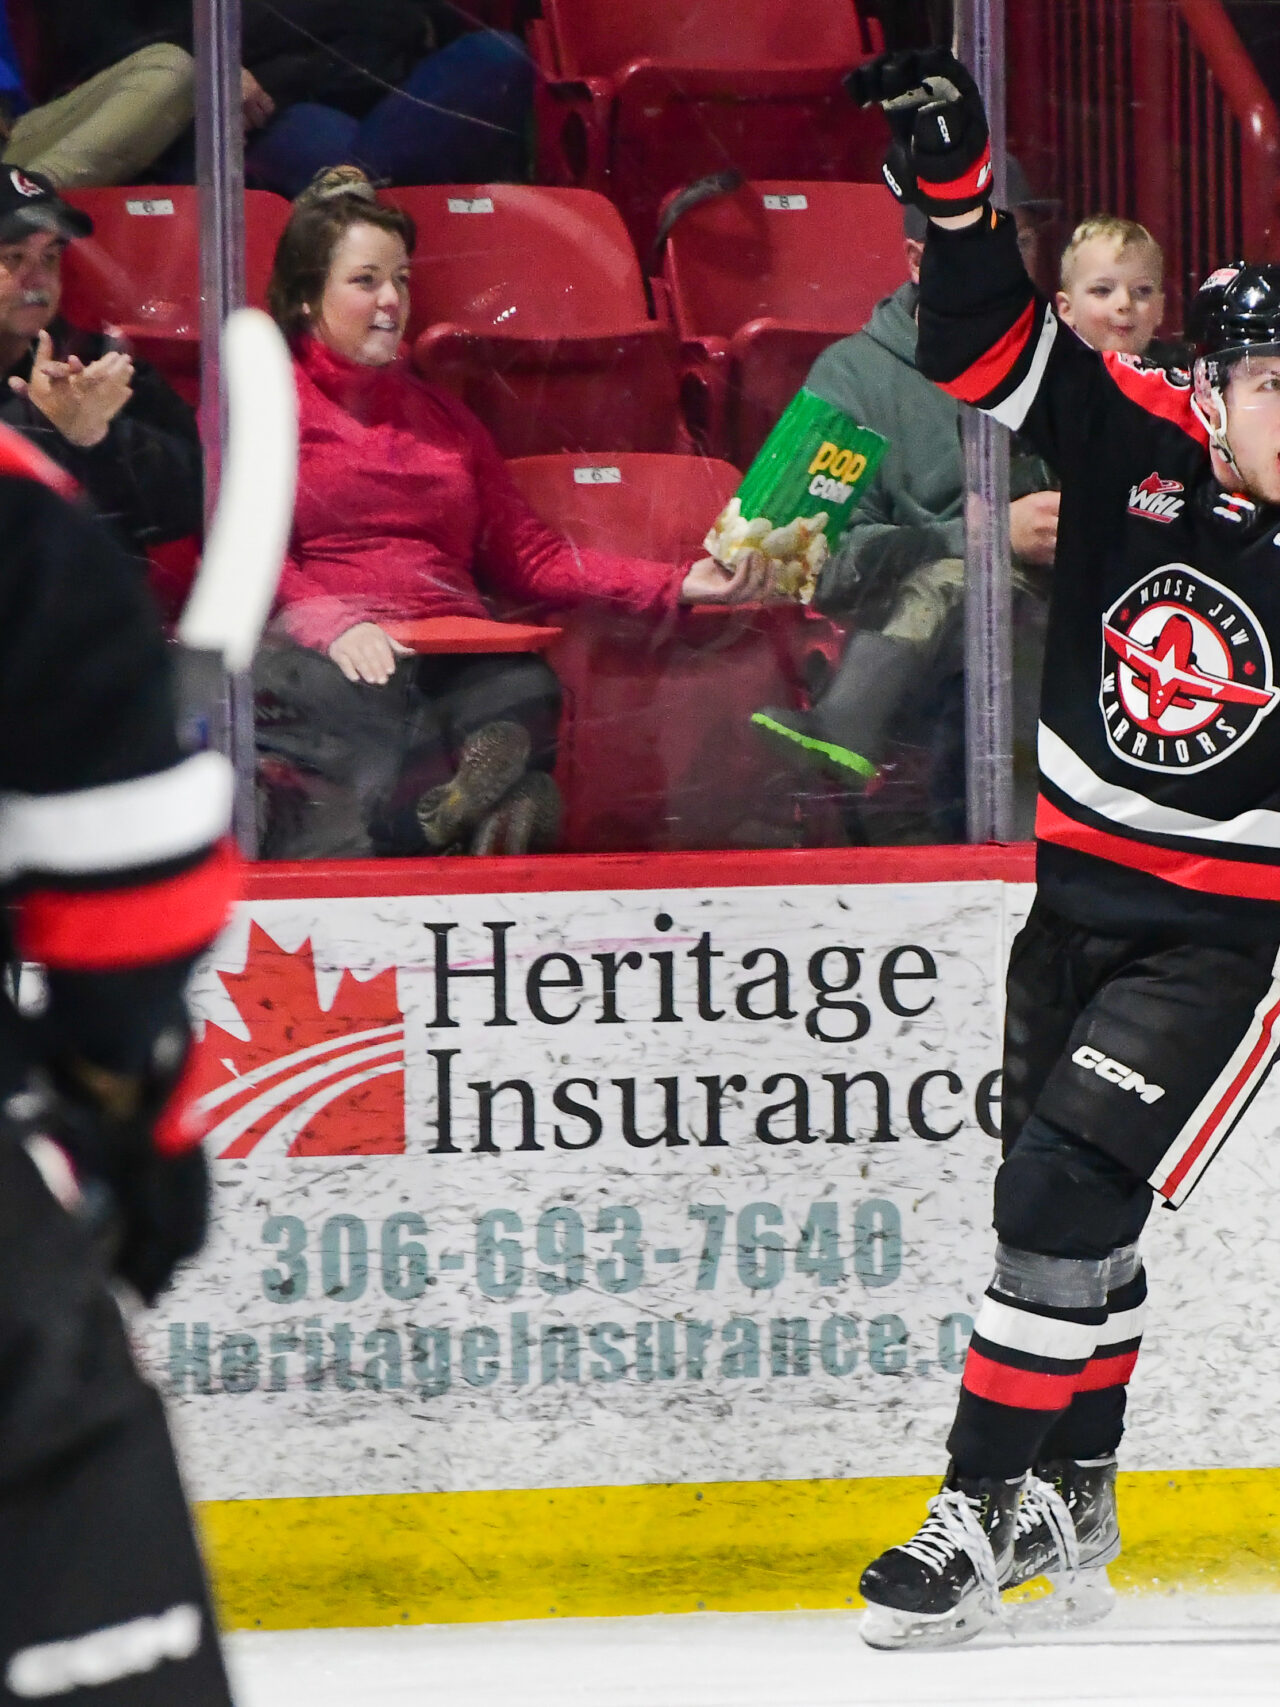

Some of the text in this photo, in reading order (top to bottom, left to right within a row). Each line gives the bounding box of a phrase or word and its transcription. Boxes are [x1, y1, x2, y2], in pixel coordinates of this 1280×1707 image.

[937, 115, 951, 144] CCM
[1128, 485, 1186, 518] WHL
[1140, 578, 1250, 646] MOOSE JAW
[1103, 671, 1238, 763] WARRIORS
[424, 912, 939, 1044] Heritage
[1071, 1045, 1166, 1104] CCM
[261, 1198, 902, 1305] 306-693-7640
[168, 1311, 976, 1399] HeritageInsurance.c
